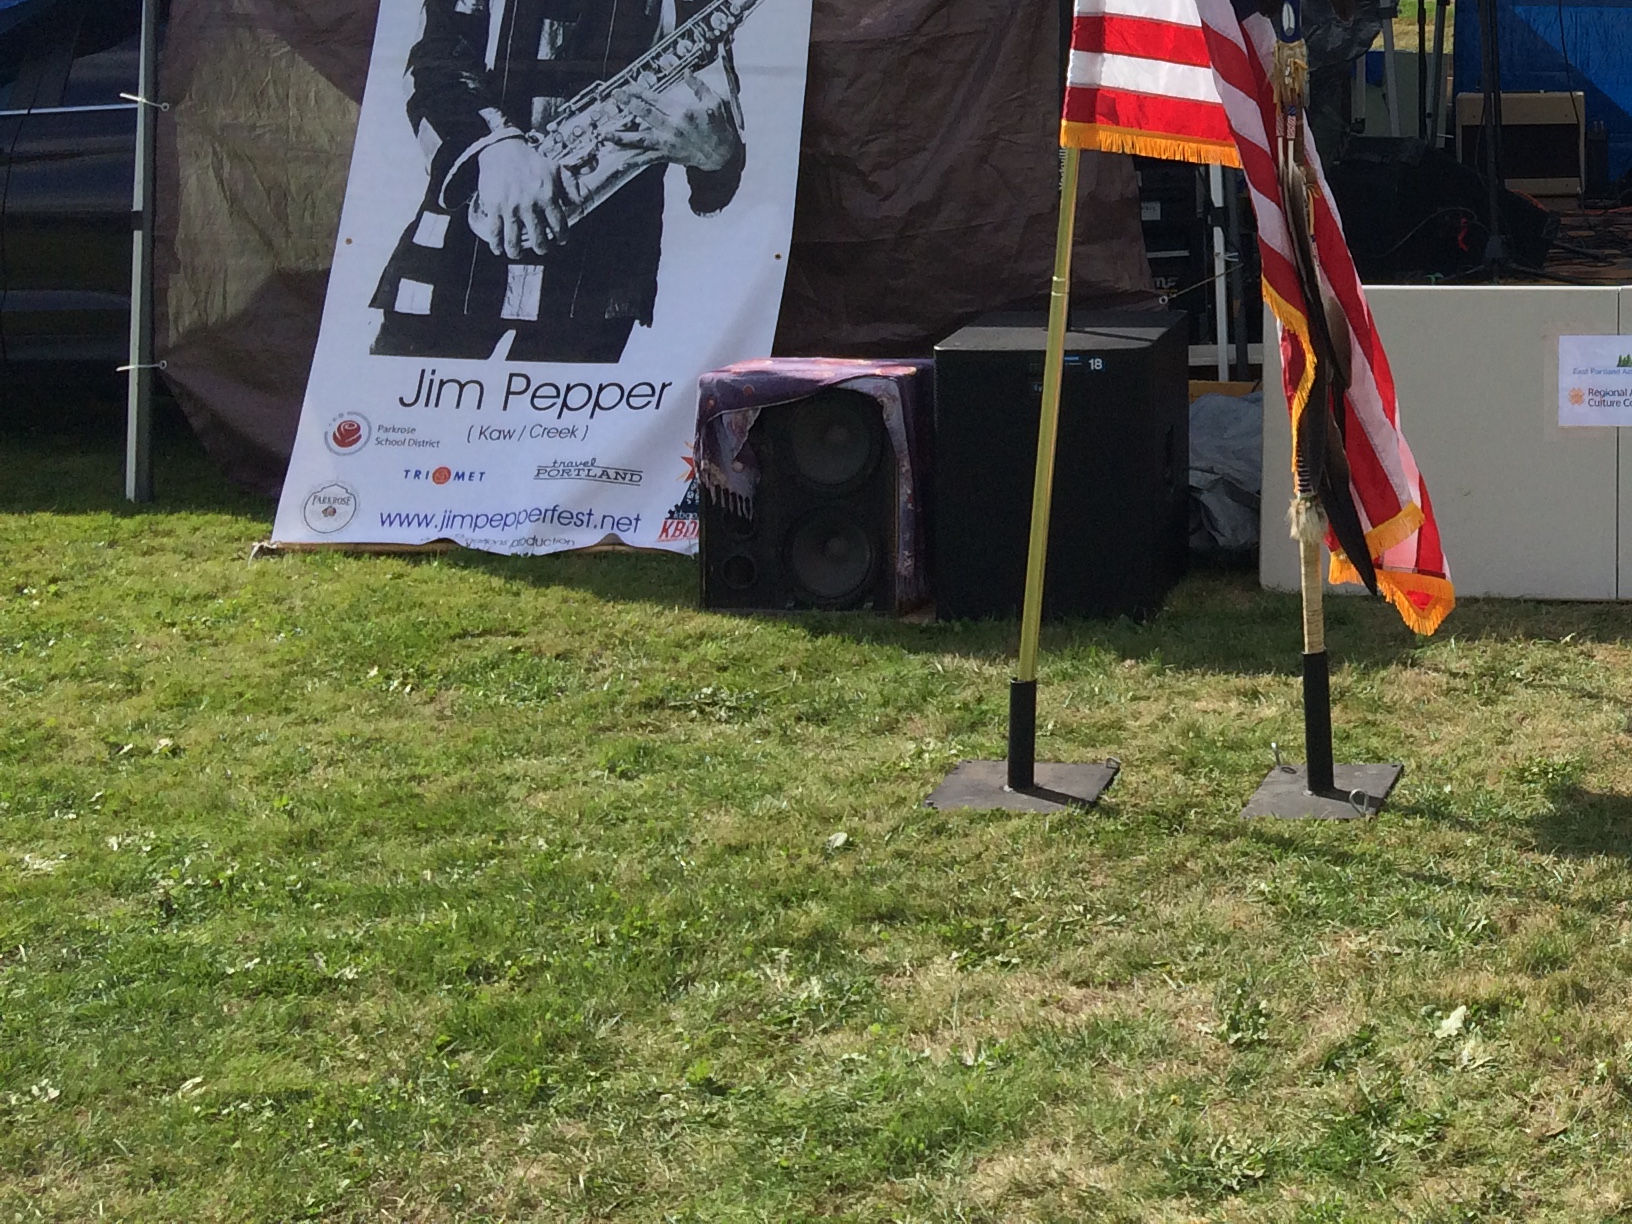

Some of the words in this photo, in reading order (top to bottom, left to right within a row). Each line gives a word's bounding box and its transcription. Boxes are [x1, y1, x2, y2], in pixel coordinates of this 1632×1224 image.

[1088, 358, 1103, 370] 18
[399, 368, 484, 410] Jim
[502, 373, 672, 420] Pepper
[1588, 388, 1627, 398] Regional
[1588, 398, 1621, 407] Culture
[377, 424, 416, 435] Parkrose
[375, 437, 406, 447] School
[407, 438, 440, 448] District
[551, 457, 597, 468] travel
[534, 468, 643, 483] PORTLAND
[379, 506, 642, 535] www.jimpepperfest.net
